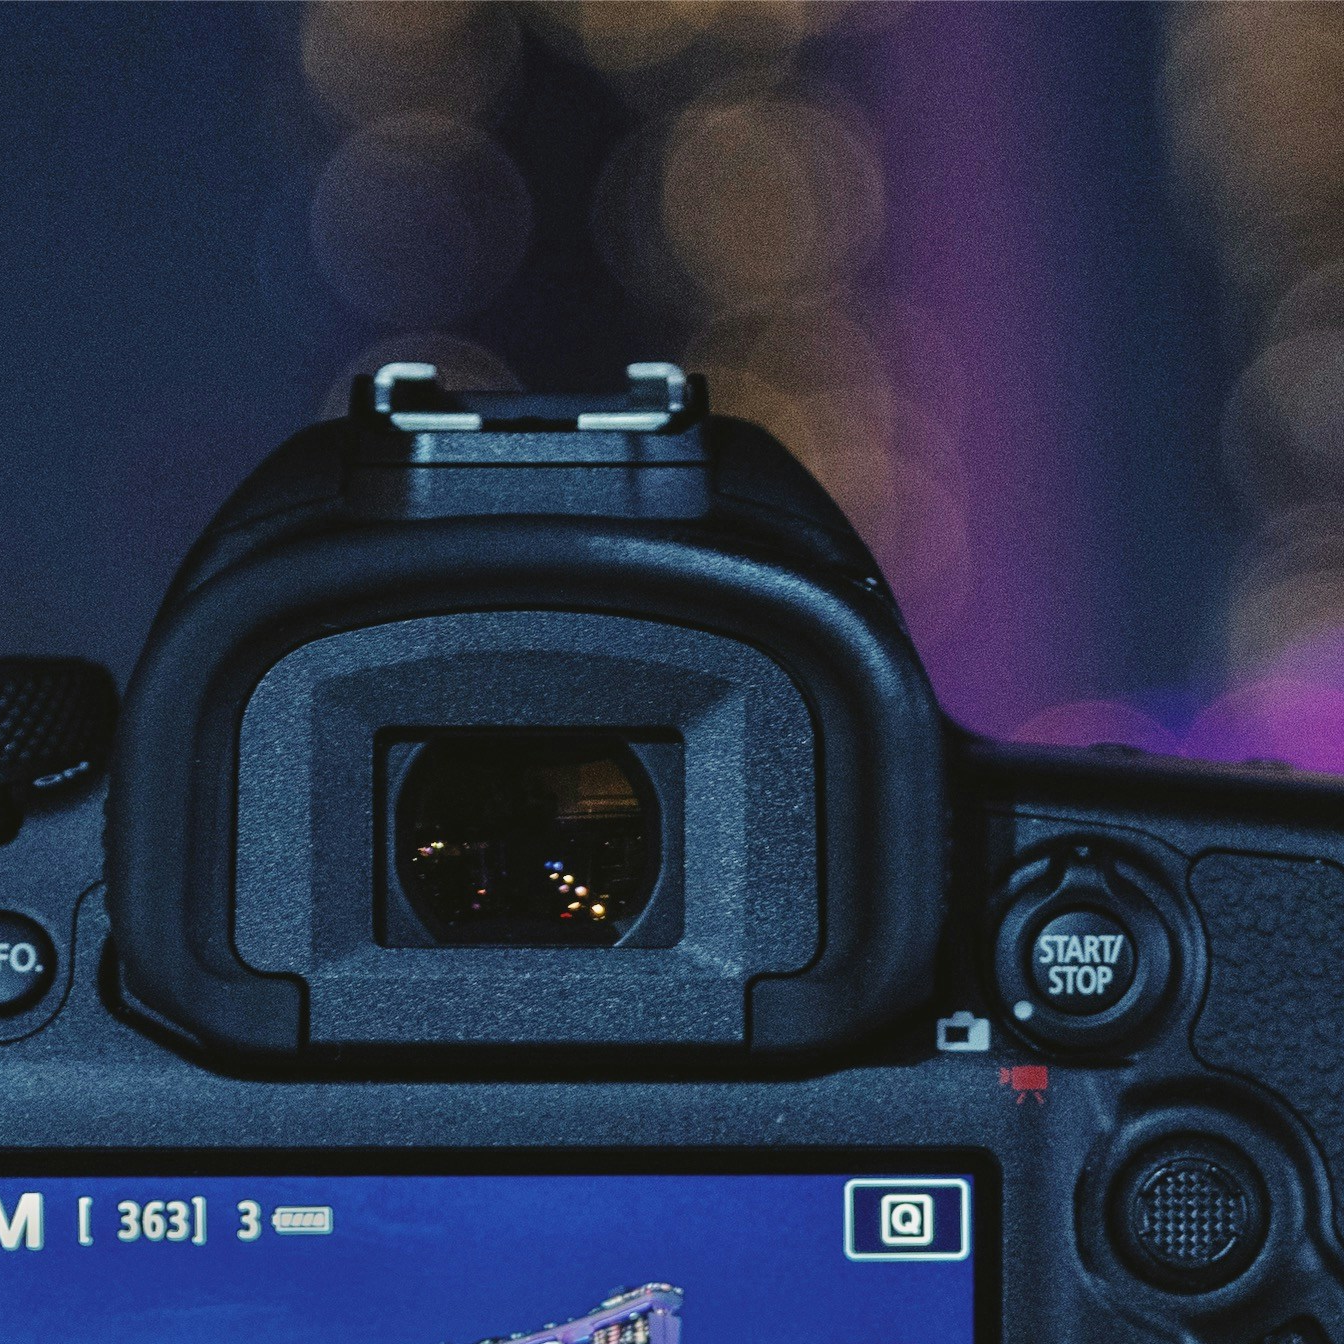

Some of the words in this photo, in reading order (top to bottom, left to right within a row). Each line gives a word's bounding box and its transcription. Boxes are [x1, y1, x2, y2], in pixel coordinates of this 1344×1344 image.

[1039, 935, 1123, 964] START/
[1048, 966, 1113, 995] STOP
[236, 1200, 261, 1242] 3
[891, 1203, 920, 1235] Q
